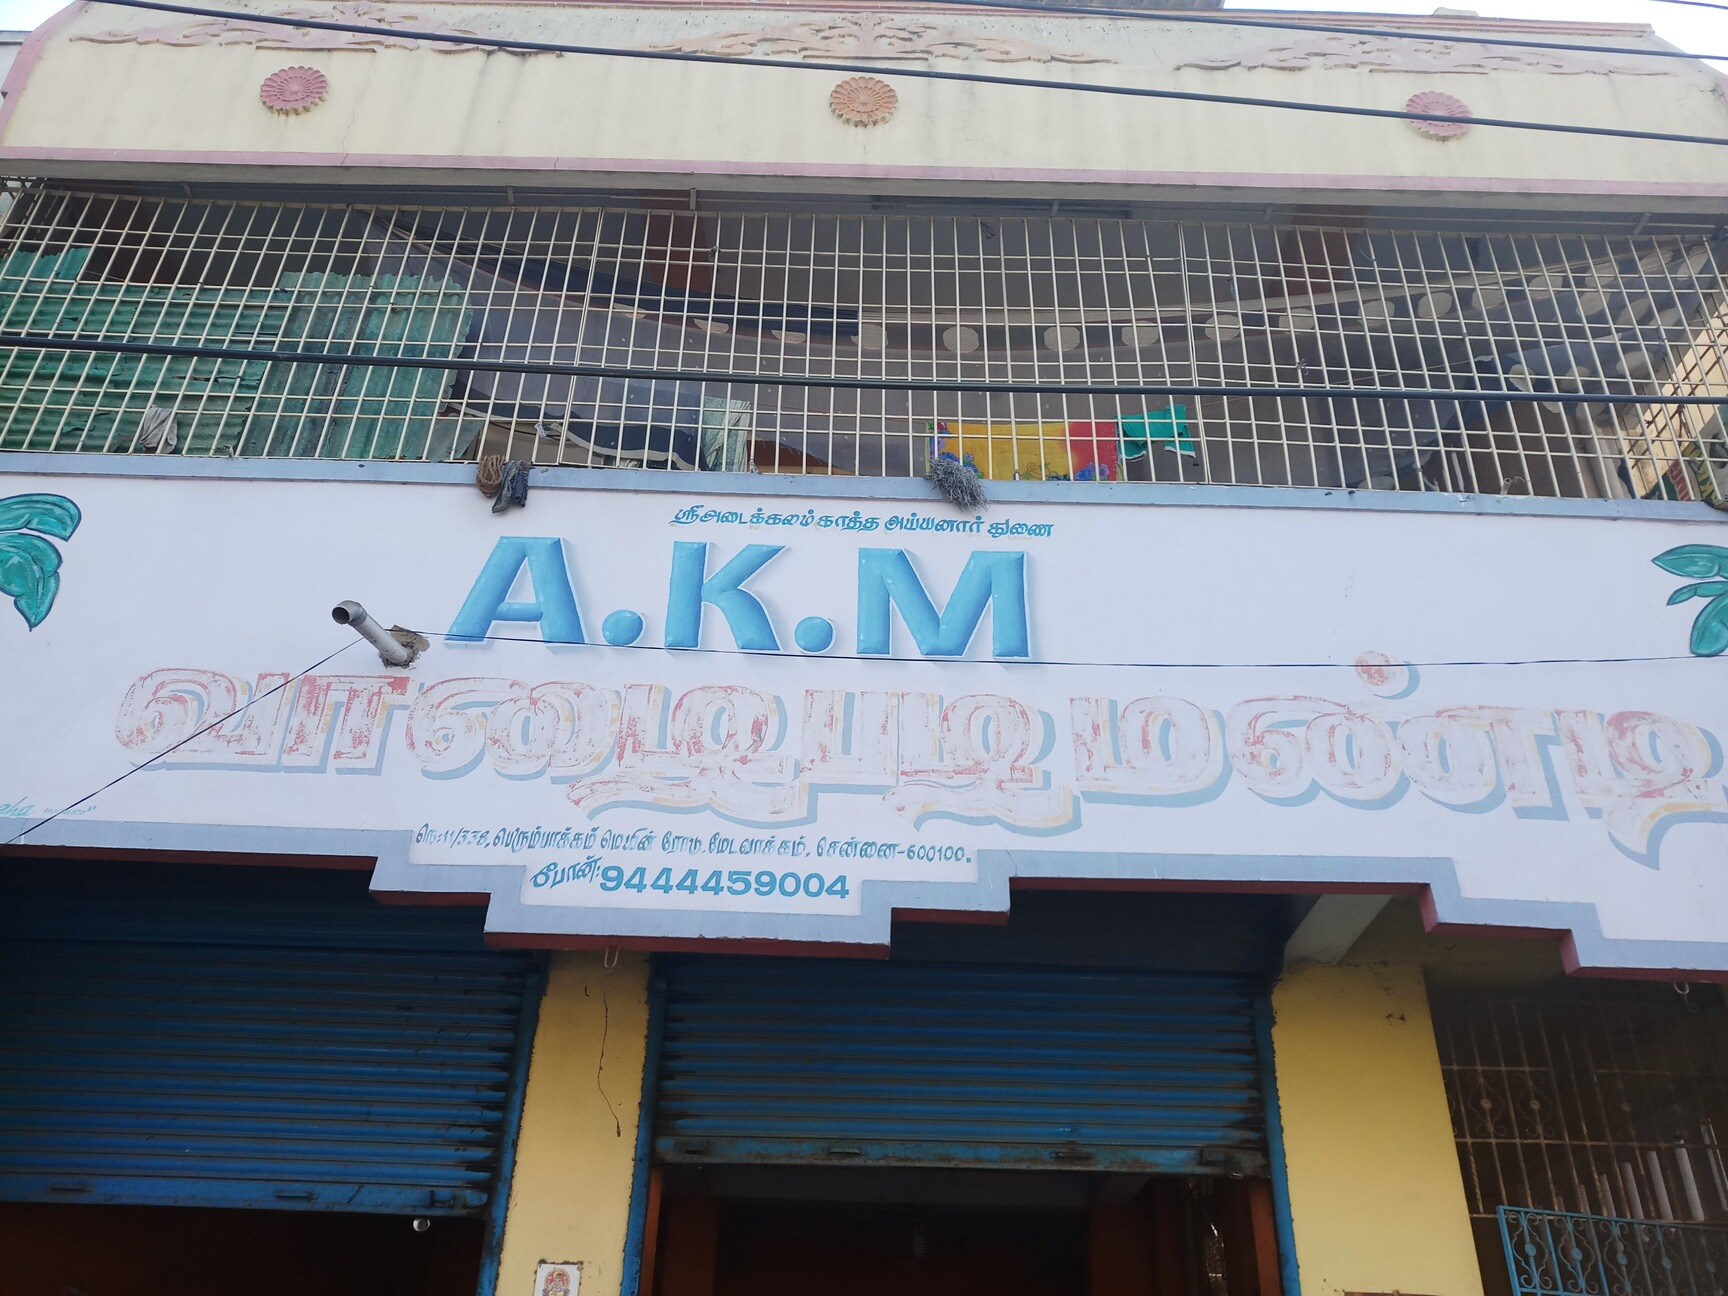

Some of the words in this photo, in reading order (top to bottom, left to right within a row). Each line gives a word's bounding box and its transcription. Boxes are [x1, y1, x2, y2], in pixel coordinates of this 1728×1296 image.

[884, 512, 985, 534] அய்யனார்
[987, 518, 1055, 539] துணை
[600, 865, 849, 899] 9444459004
